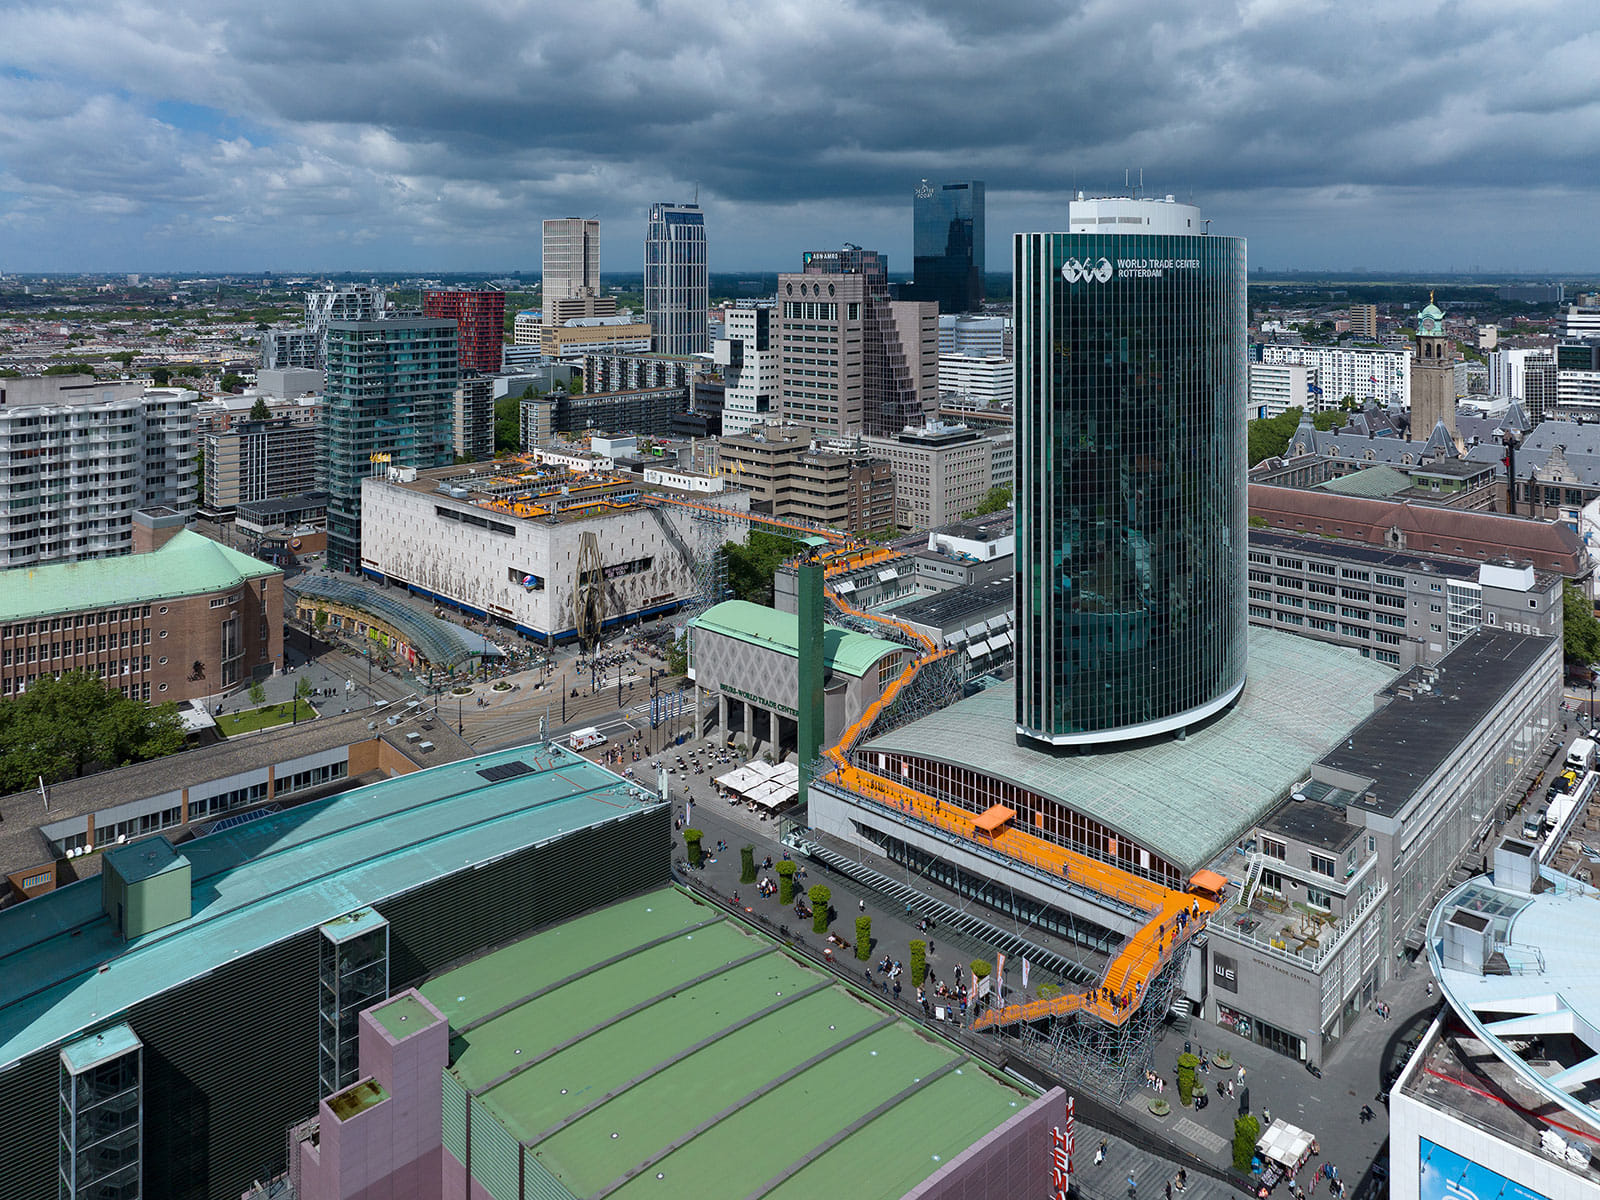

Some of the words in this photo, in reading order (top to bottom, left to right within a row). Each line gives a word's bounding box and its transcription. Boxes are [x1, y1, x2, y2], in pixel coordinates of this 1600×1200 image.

[1117, 259, 1147, 269] WORLD
[1148, 259, 1173, 269] TRADE
[1175, 259, 1200, 269] CENTER
[1118, 269, 1162, 278] ROTTERDAM
[758, 696, 777, 709] TRADE
[777, 703, 799, 716] CENTER
[1215, 964, 1235, 981] WE
[1253, 957, 1271, 968] WORLD
[1272, 965, 1289, 976] TRADE
[1290, 973, 1311, 984] CENTER
